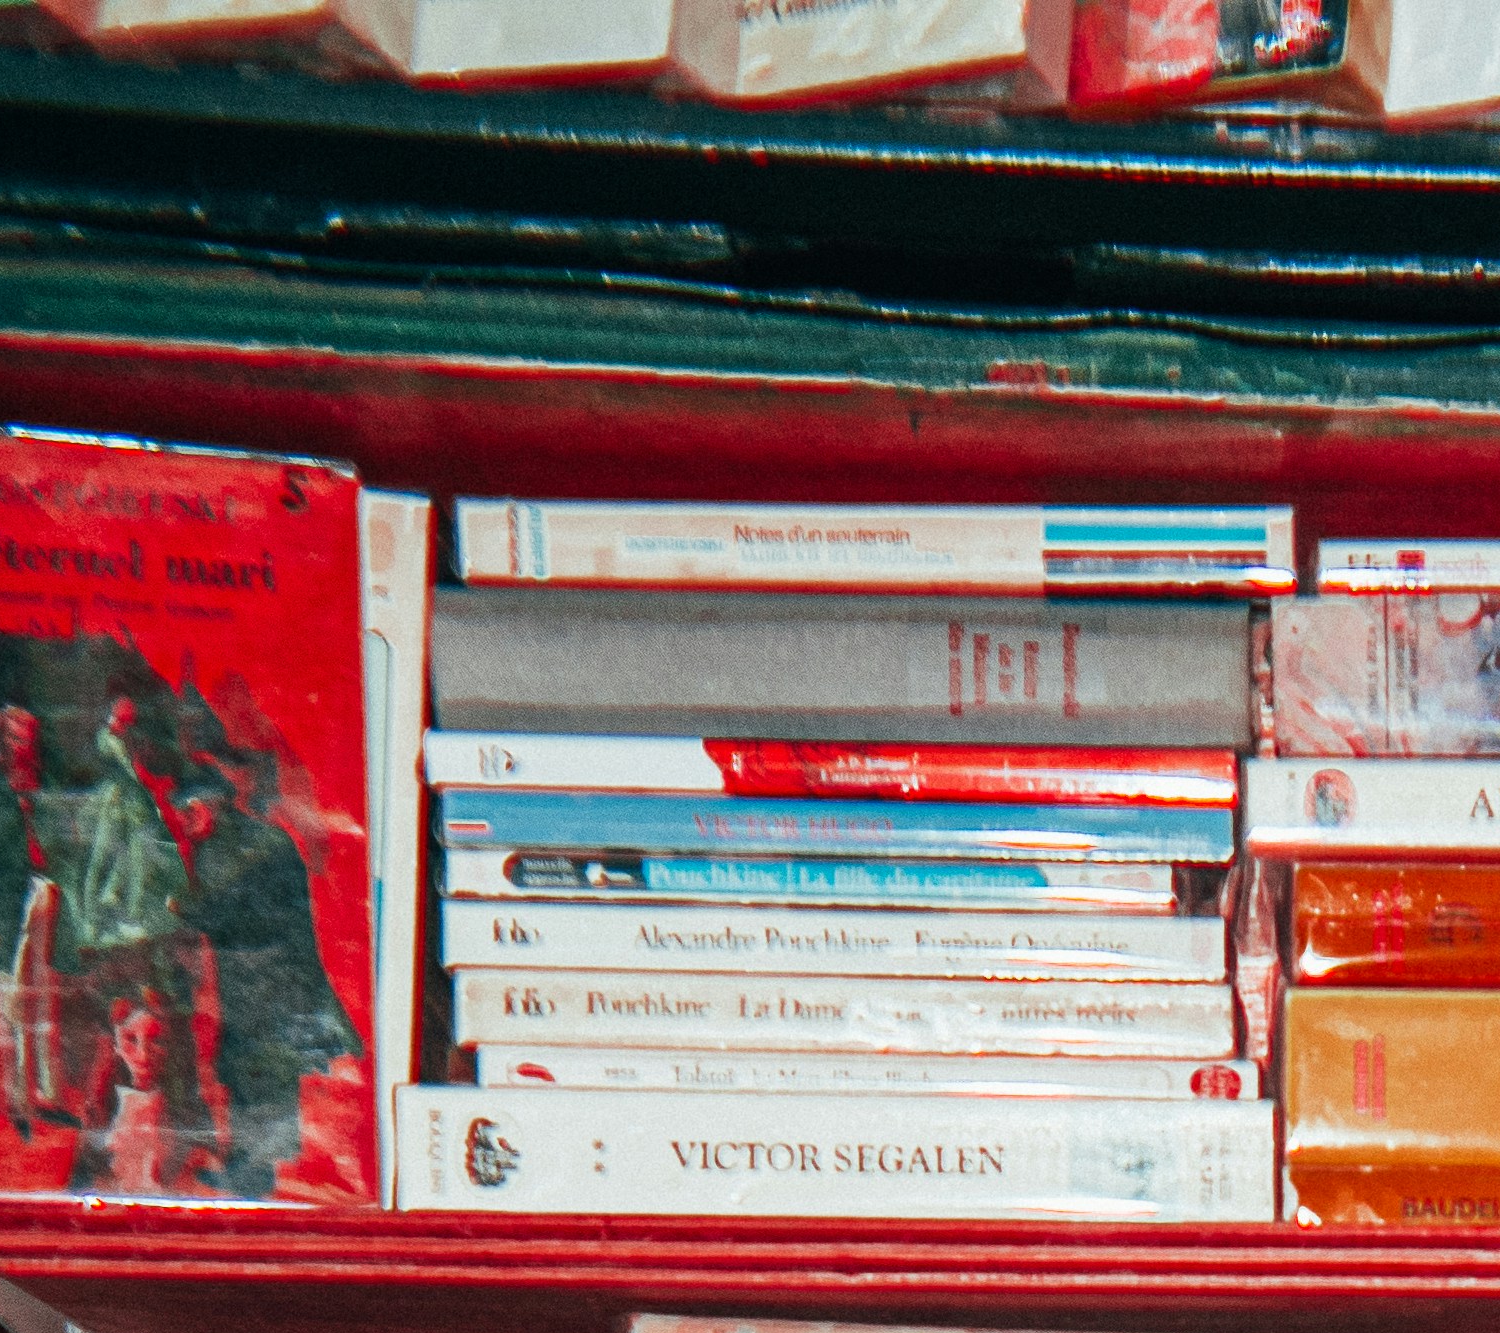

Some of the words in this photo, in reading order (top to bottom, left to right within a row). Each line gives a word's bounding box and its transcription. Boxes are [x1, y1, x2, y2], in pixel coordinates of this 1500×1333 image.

[165, 551, 276, 593] mari
[670, 1138, 827, 1176] VICTOR
[832, 1141, 1006, 1179] SEGALEN
